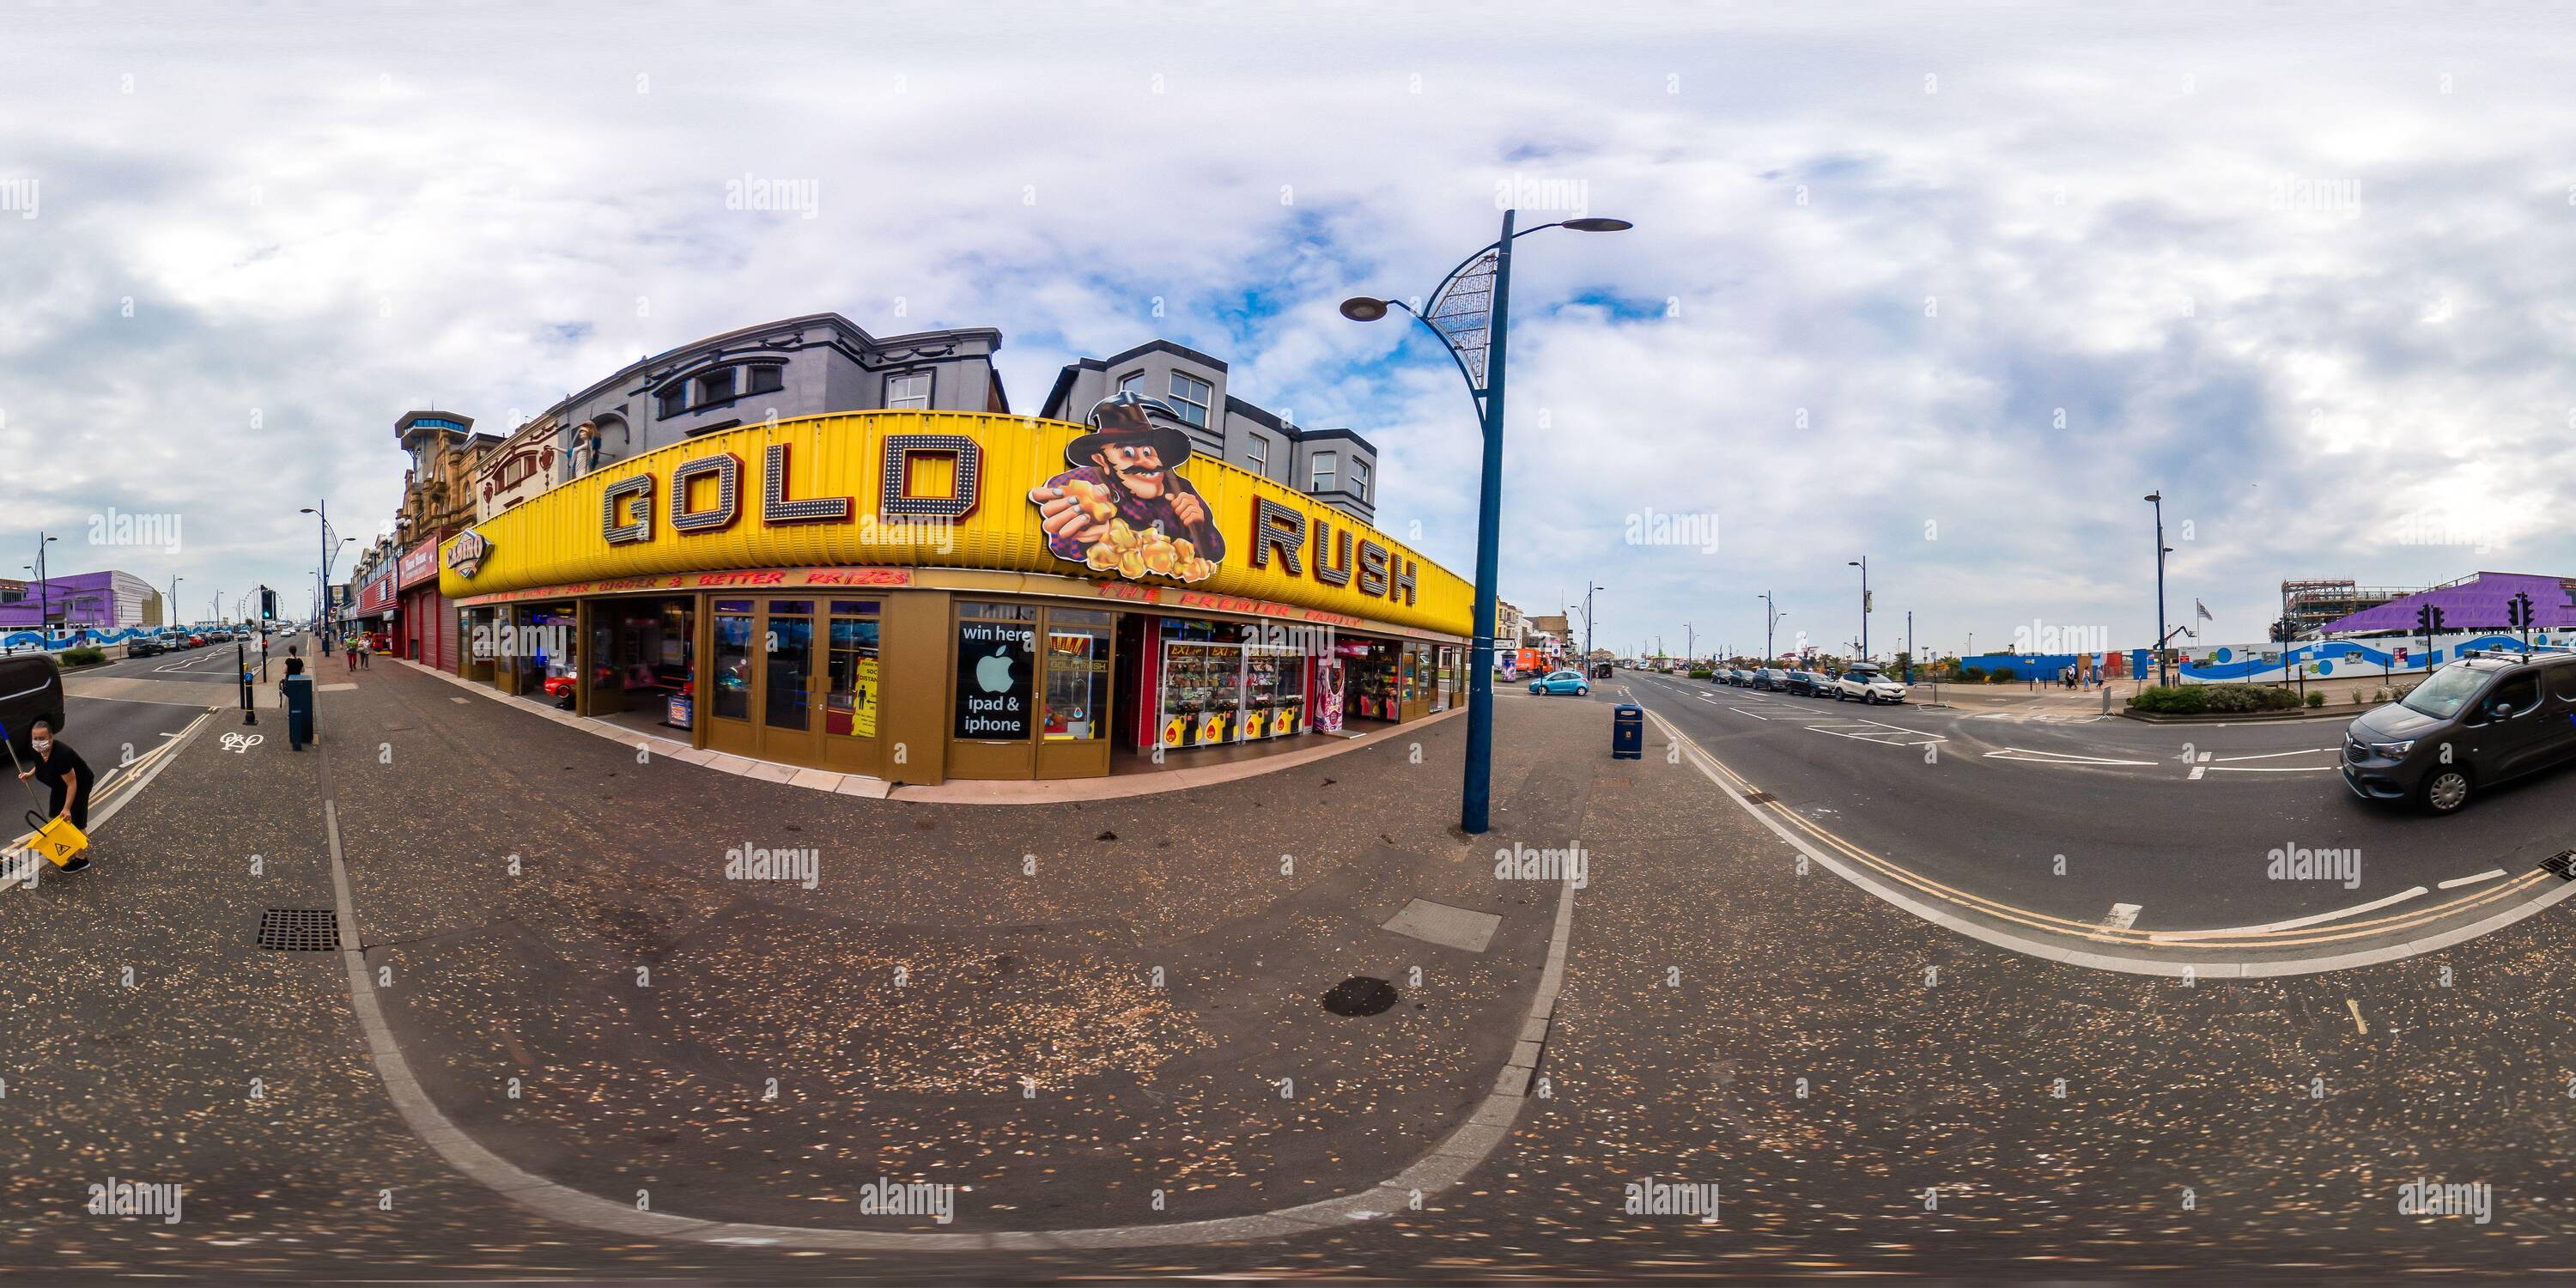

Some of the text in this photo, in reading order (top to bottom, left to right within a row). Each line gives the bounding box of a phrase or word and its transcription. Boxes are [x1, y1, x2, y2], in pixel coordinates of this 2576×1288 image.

[603, 433, 1417, 606] GOLD RUSH
[447, 534, 484, 568] CASINO
[668, 576, 683, 587] &
[697, 570, 787, 586] BETTER
[1098, 581, 1363, 627] THE PREMIER FAMILY
[963, 625, 1031, 641] win here
[969, 696, 1019, 714] ipad &
[965, 716, 1021, 733] iphone
